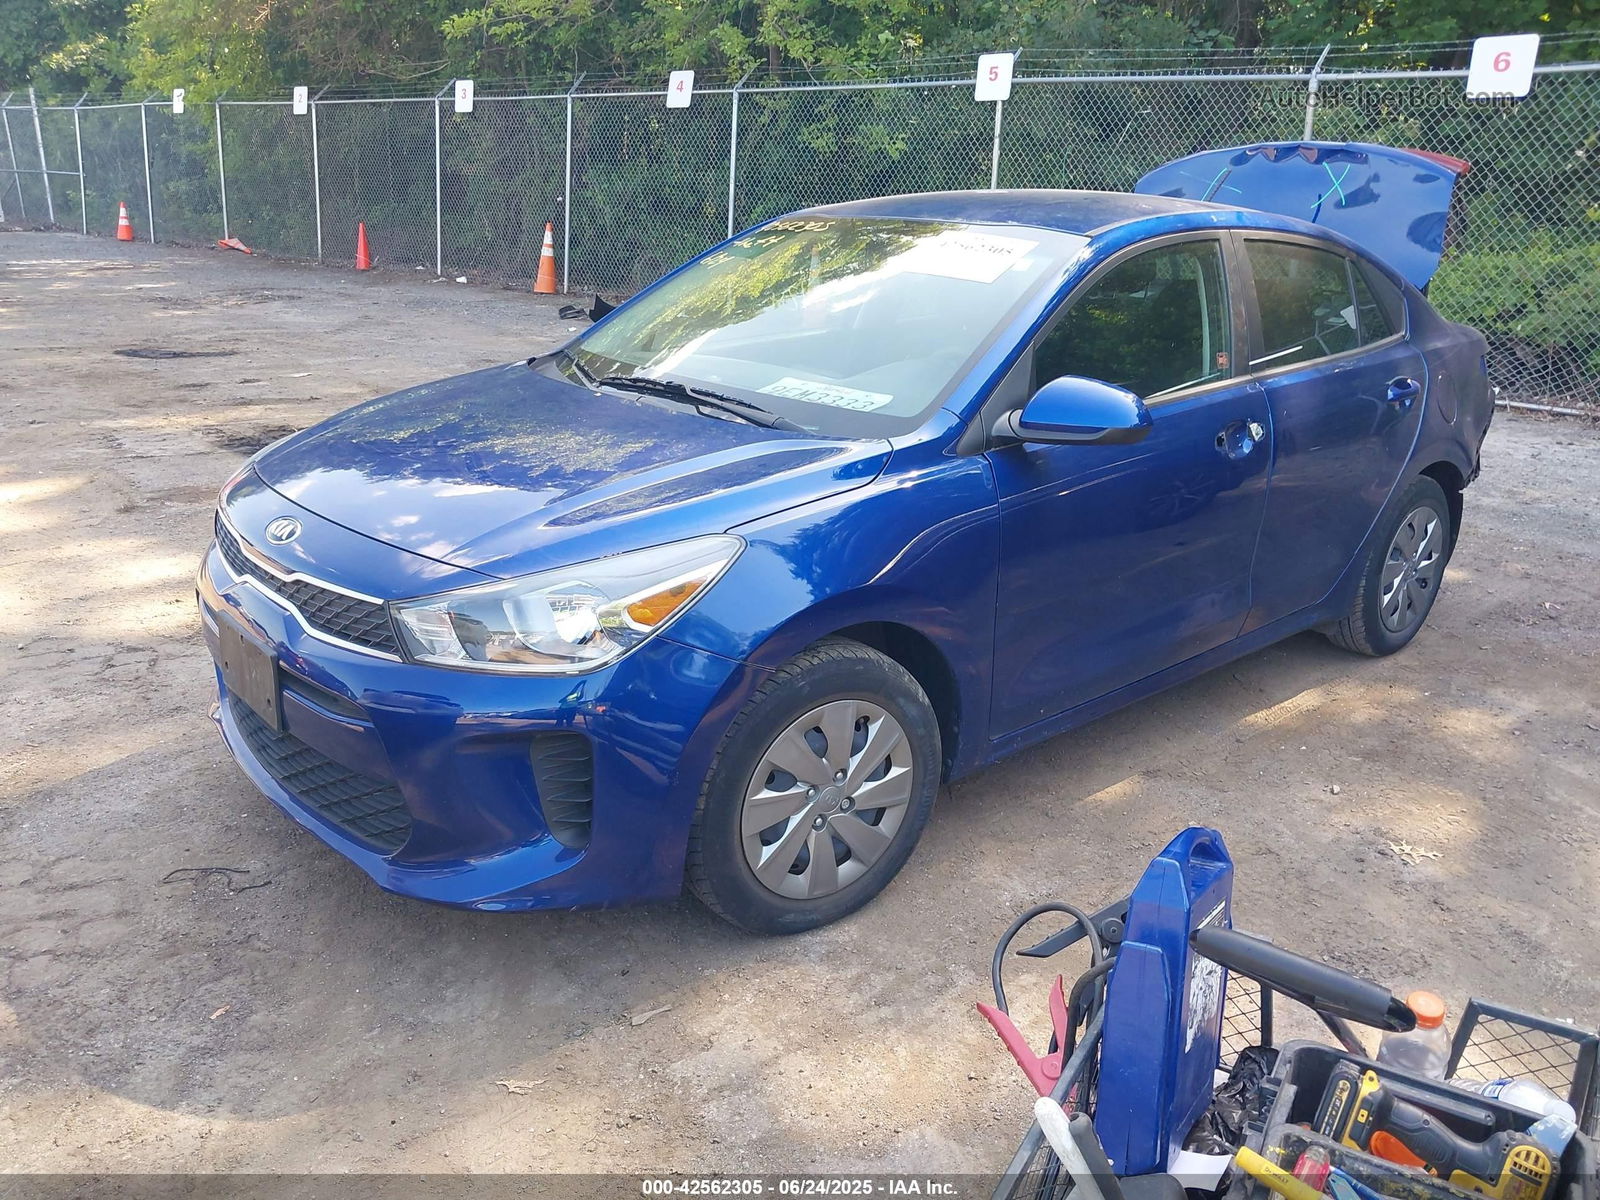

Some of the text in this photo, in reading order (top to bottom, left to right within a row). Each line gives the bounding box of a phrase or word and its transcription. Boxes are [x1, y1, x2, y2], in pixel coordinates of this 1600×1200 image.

[1493, 51, 1511, 73] 6
[988, 66, 999, 82] 5
[676, 80, 684, 93] 4
[461, 88, 467, 100] 3
